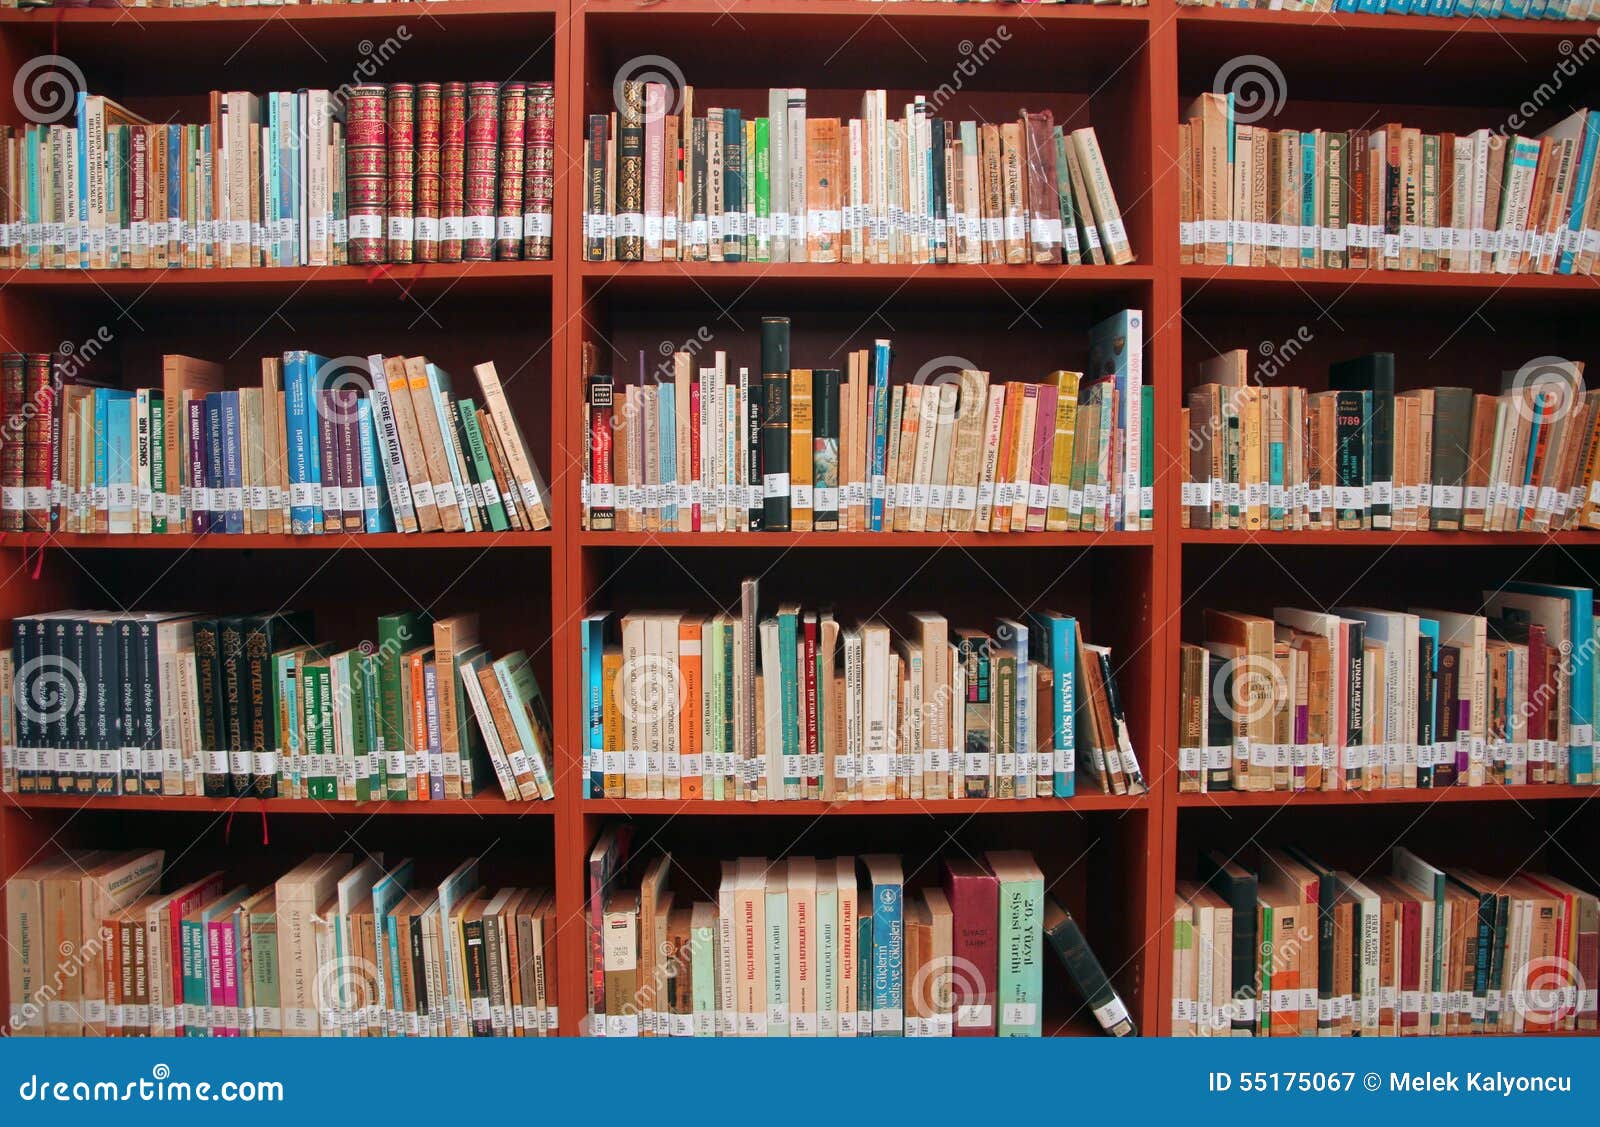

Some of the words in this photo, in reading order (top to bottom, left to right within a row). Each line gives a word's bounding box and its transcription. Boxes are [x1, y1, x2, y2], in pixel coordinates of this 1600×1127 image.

[1254, 135, 1265, 198] BARBAROSSA
[1508, 171, 1522, 208] Gerçekler
[1506, 209, 1515, 225] Yeni
[153, 407, 162, 418] BATI
[378, 391, 391, 421] ASKERE
[751, 403, 759, 419] ateş
[139, 417, 148, 435] NUR
[153, 418, 162, 439] ANADOLU
[463, 405, 476, 431] HORASAN
[1338, 416, 1360, 426] 1789
[384, 423, 395, 437] DİN
[750, 420, 758, 443] uykusu
[139, 436, 148, 466] SONSUZ
[387, 439, 400, 465] KİTABI
[985, 450, 995, 483] MARCUSE
[305, 676, 313, 686] BATI
[320, 673, 329, 684] BATI
[305, 687, 314, 708] ANADOLU
[320, 684, 329, 706] ANADOLU
[1061, 672, 1072, 712] YAŞAMI
[807, 689, 815, 731] KİTABELERİ
[1354, 690, 1362, 729] MEZALİMİ
[1061, 715, 1073, 746] SEÇİN
[312, 785, 317, 795] 1
[327, 784, 333, 793] 2
[434, 782, 441, 792] 2
[843, 901, 851, 923] TARİHİ
[1011, 892, 1022, 931] Siyasi
[1024, 899, 1034, 920] 20.
[122, 928, 131, 945] KUZEY
[136, 928, 144, 945] KUZEY
[182, 926, 190, 945] BAĞDAT
[192, 928, 201, 948] BAĞDAT
[211, 929, 219, 956] HİNDİSTAN
[224, 928, 233, 955] HİNDİSTAN
[799, 926, 807, 960] SEFERLERİ
[843, 924, 851, 959] SEFERLERİ
[887, 920, 901, 968] Çöküşleri
[1023, 925, 1034, 966] Yüzyıl
[122, 946, 131, 964] AFRİKA
[136, 946, 144, 964] AFRİKA
[1011, 934, 1022, 974] Tarihi
[212, 959, 221, 987] EVLİYALARI
[747, 961, 755, 980] HAÇLI
[799, 961, 808, 981] HAÇLI
[875, 946, 889, 990] Güçlerin
[891, 970, 900, 981] ve
